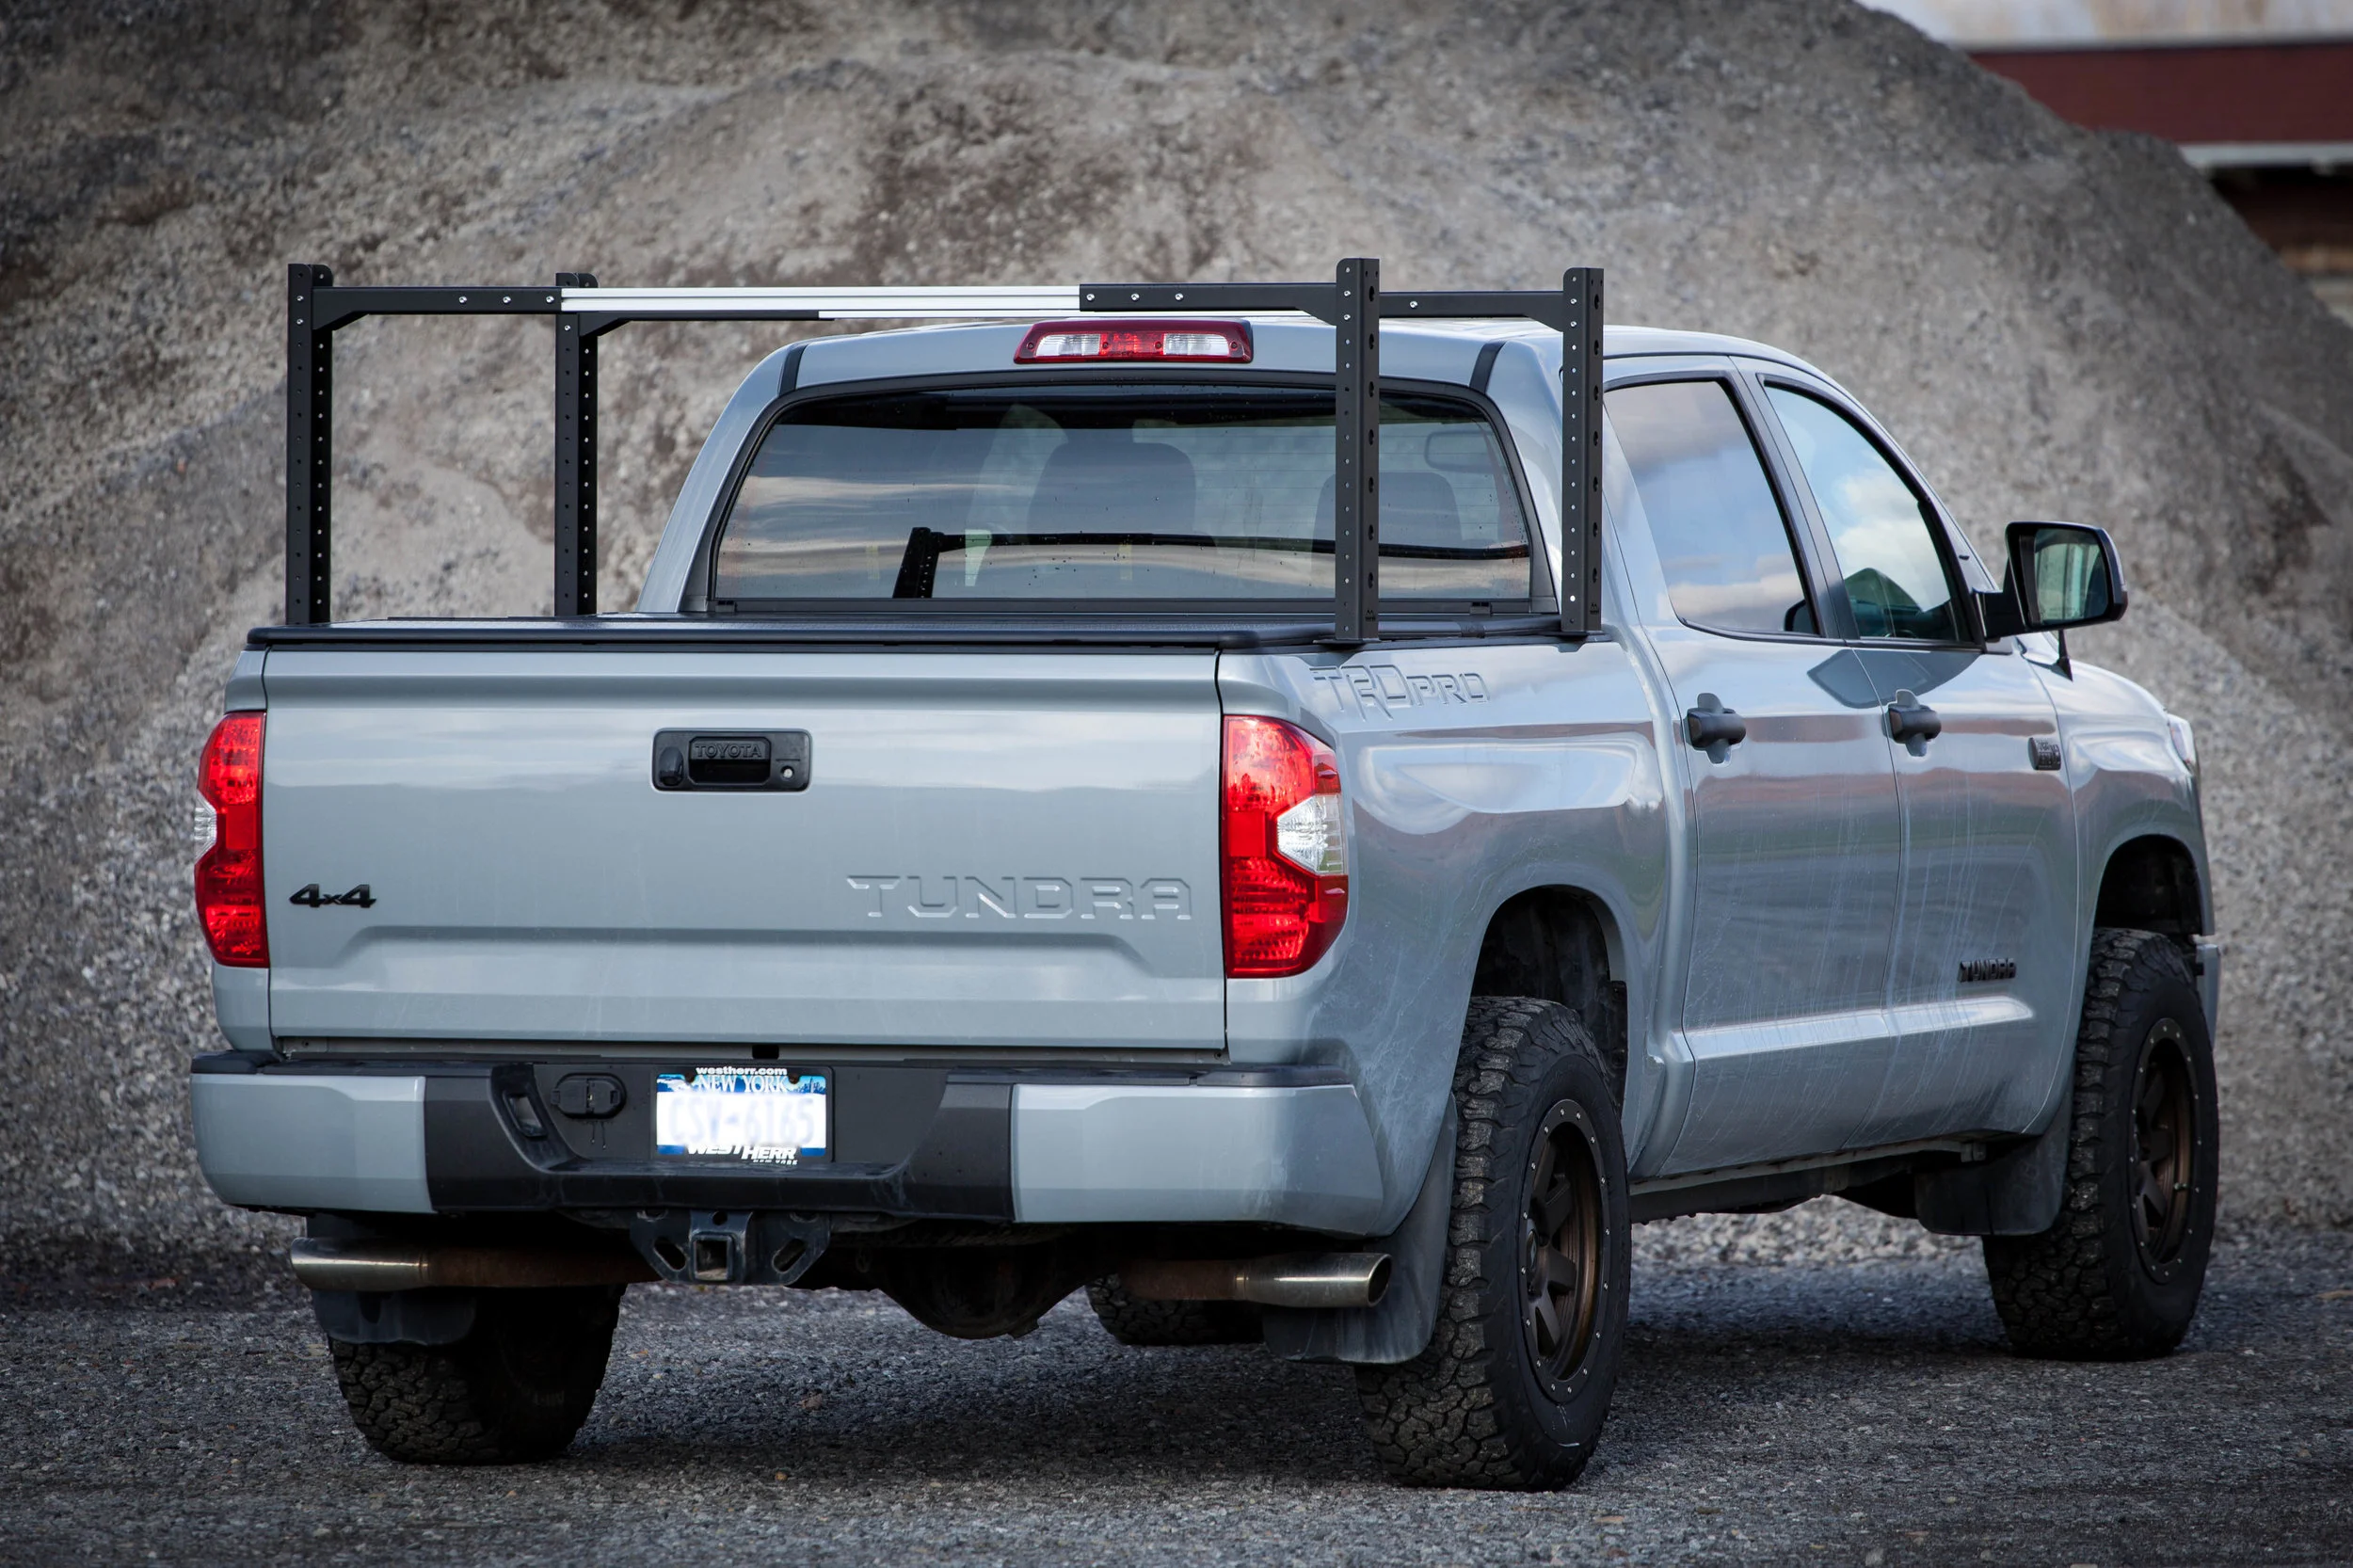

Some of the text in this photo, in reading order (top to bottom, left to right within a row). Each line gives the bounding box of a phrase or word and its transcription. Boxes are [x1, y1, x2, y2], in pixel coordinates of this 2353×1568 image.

[1308, 664, 1491, 722] TRD PRO
[695, 744, 763, 759] TOYOTA
[847, 875, 1192, 920] TUNDRA
[1958, 958, 2017, 983] TUNDRA
[696, 1066, 788, 1076] westherr.com
[698, 1075, 789, 1093] NEW YORK
[740, 1144, 797, 1160] HERR
